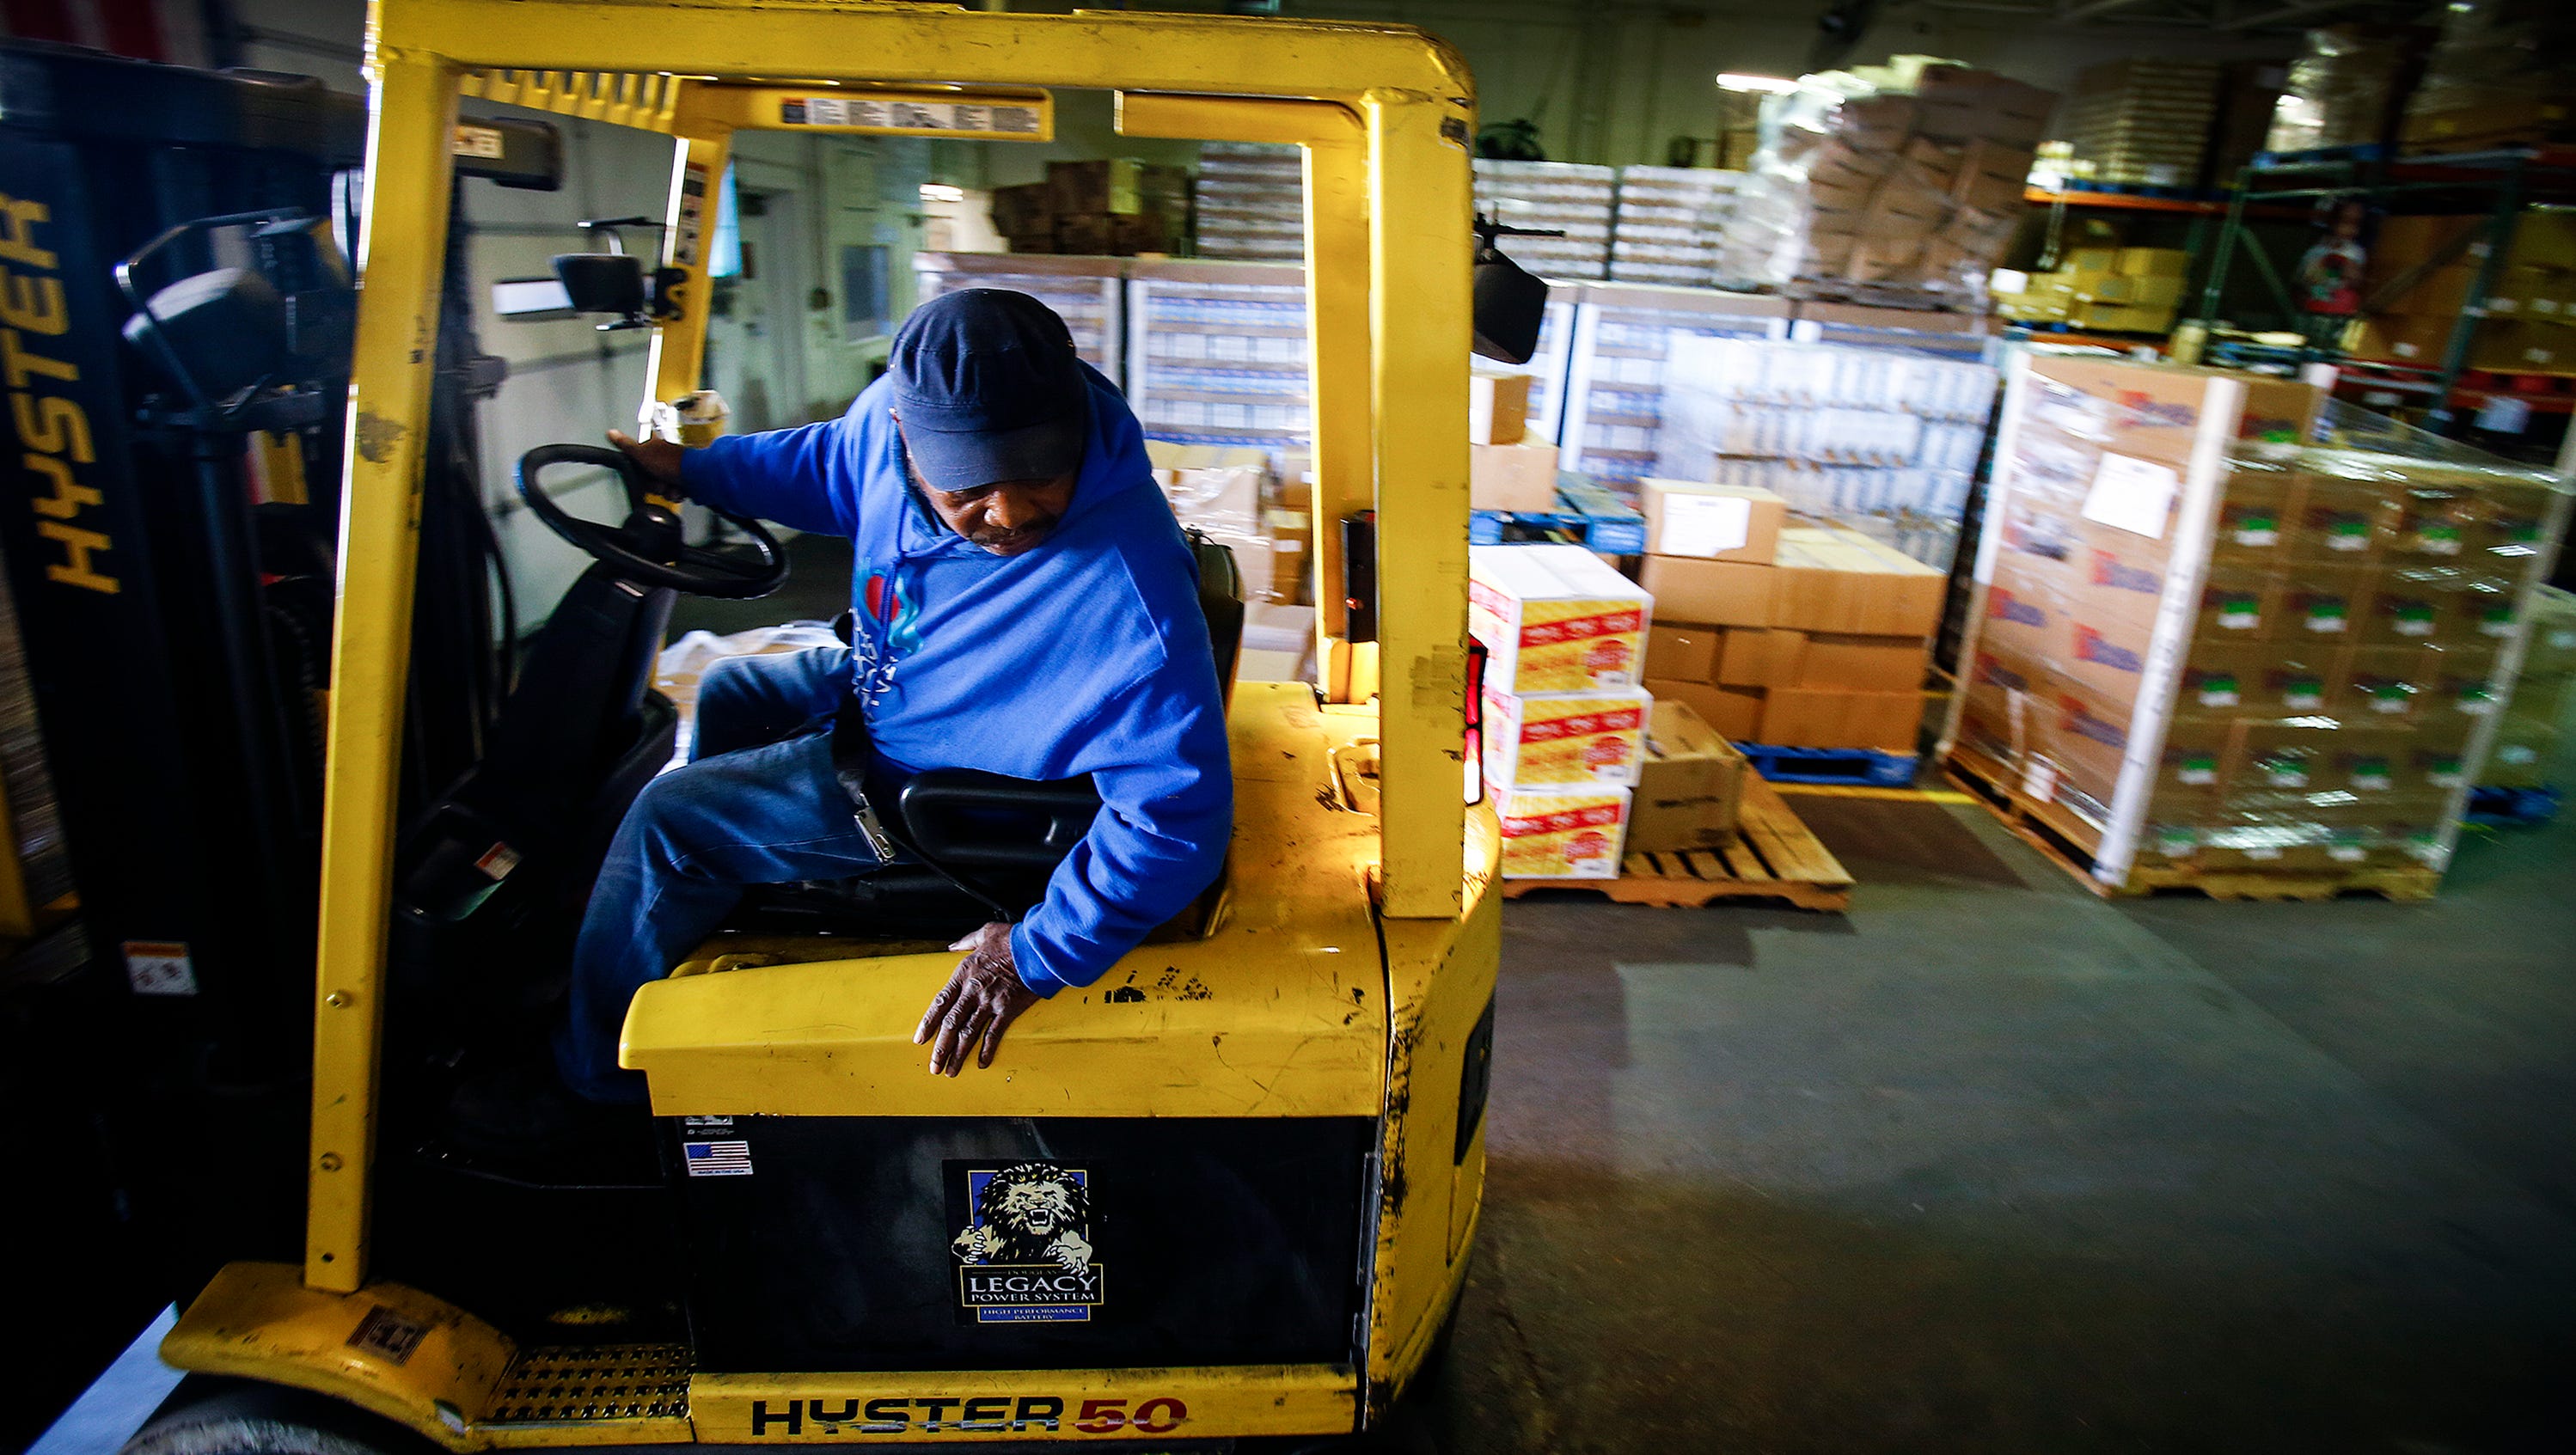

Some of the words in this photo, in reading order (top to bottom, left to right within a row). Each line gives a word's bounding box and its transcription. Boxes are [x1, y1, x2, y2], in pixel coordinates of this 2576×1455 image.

[0, 193, 120, 595] HYSTER
[970, 1276, 1098, 1293] LEGACY
[971, 1293, 1030, 1302] POWER
[1034, 1293, 1095, 1301] SYSTEM
[752, 1397, 1065, 1436] HYSTER
[1074, 1397, 1189, 1434] 50
